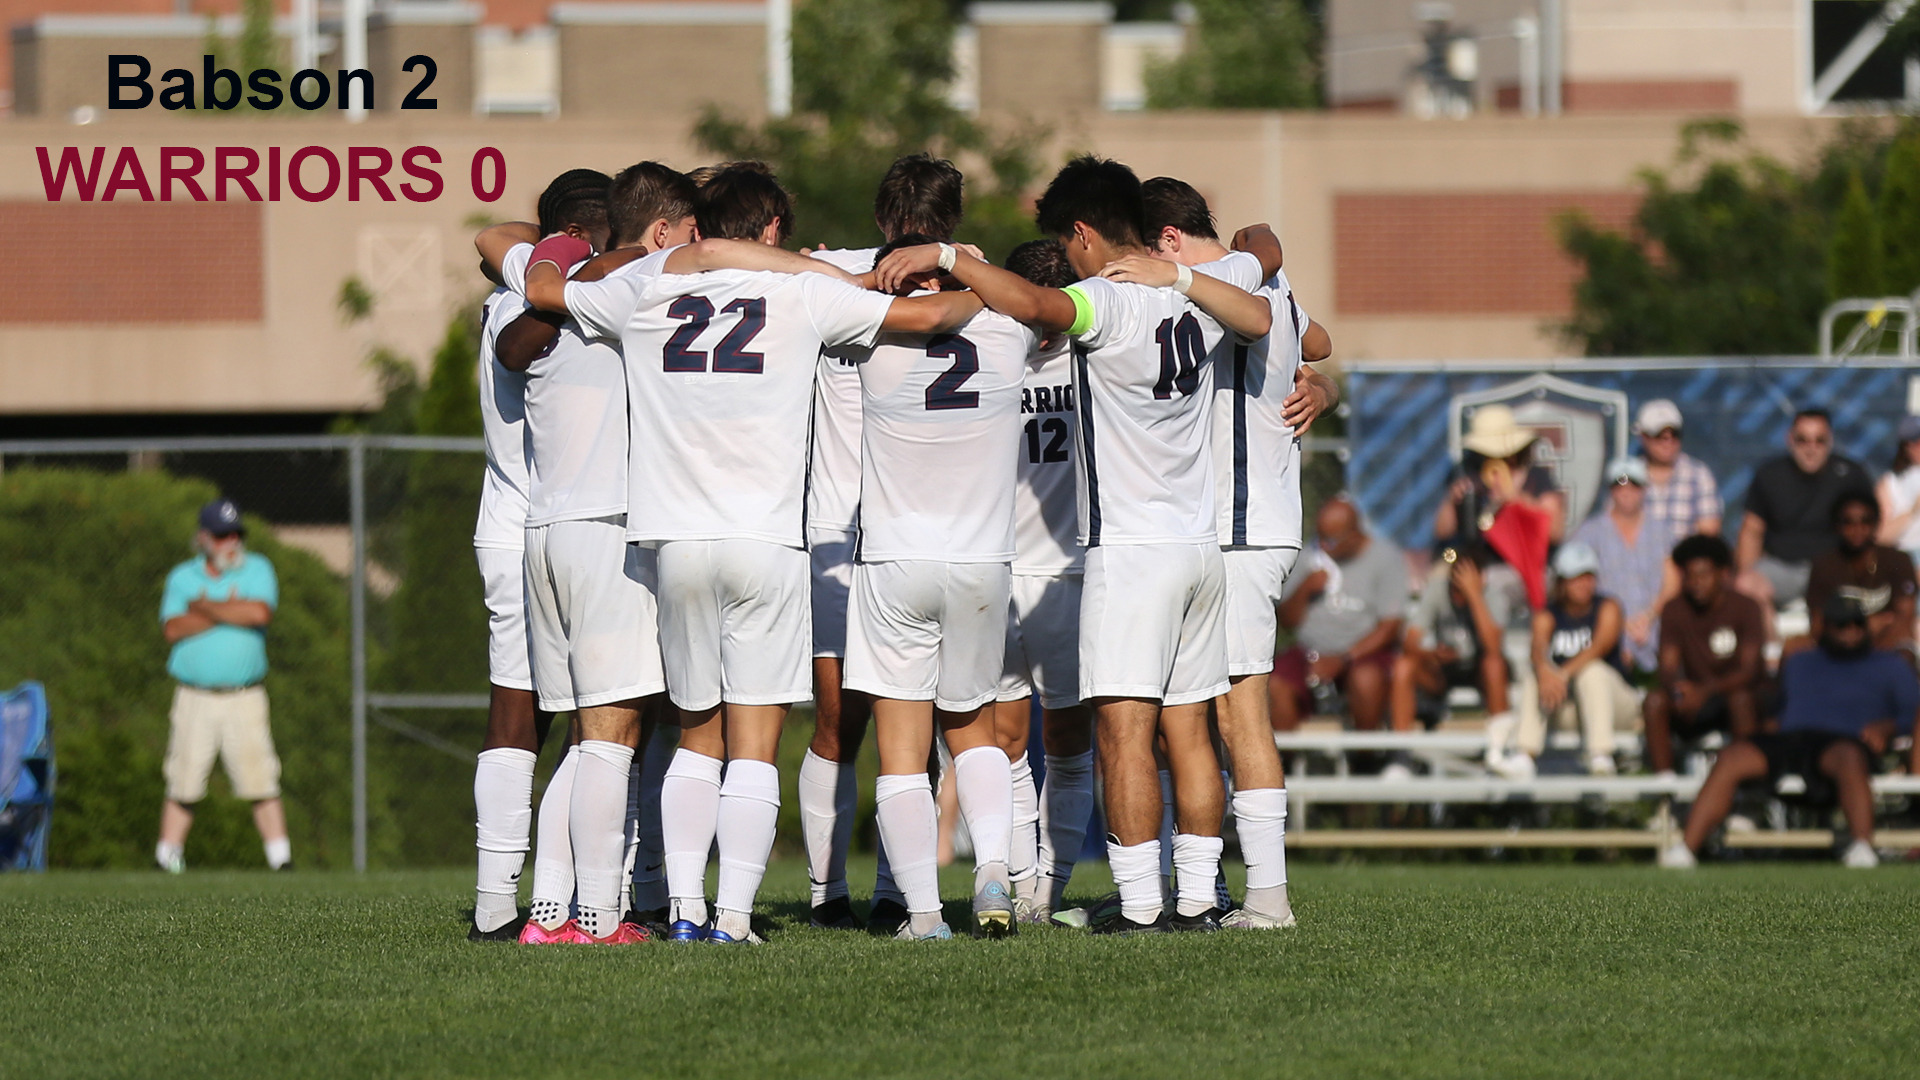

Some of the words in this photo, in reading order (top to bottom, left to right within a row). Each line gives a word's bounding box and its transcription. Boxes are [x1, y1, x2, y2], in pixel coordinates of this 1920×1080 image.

[663, 295, 766, 374] 22
[925, 333, 980, 411] 2
[1152, 311, 1207, 400] 10
[1024, 418, 1068, 464] 12
